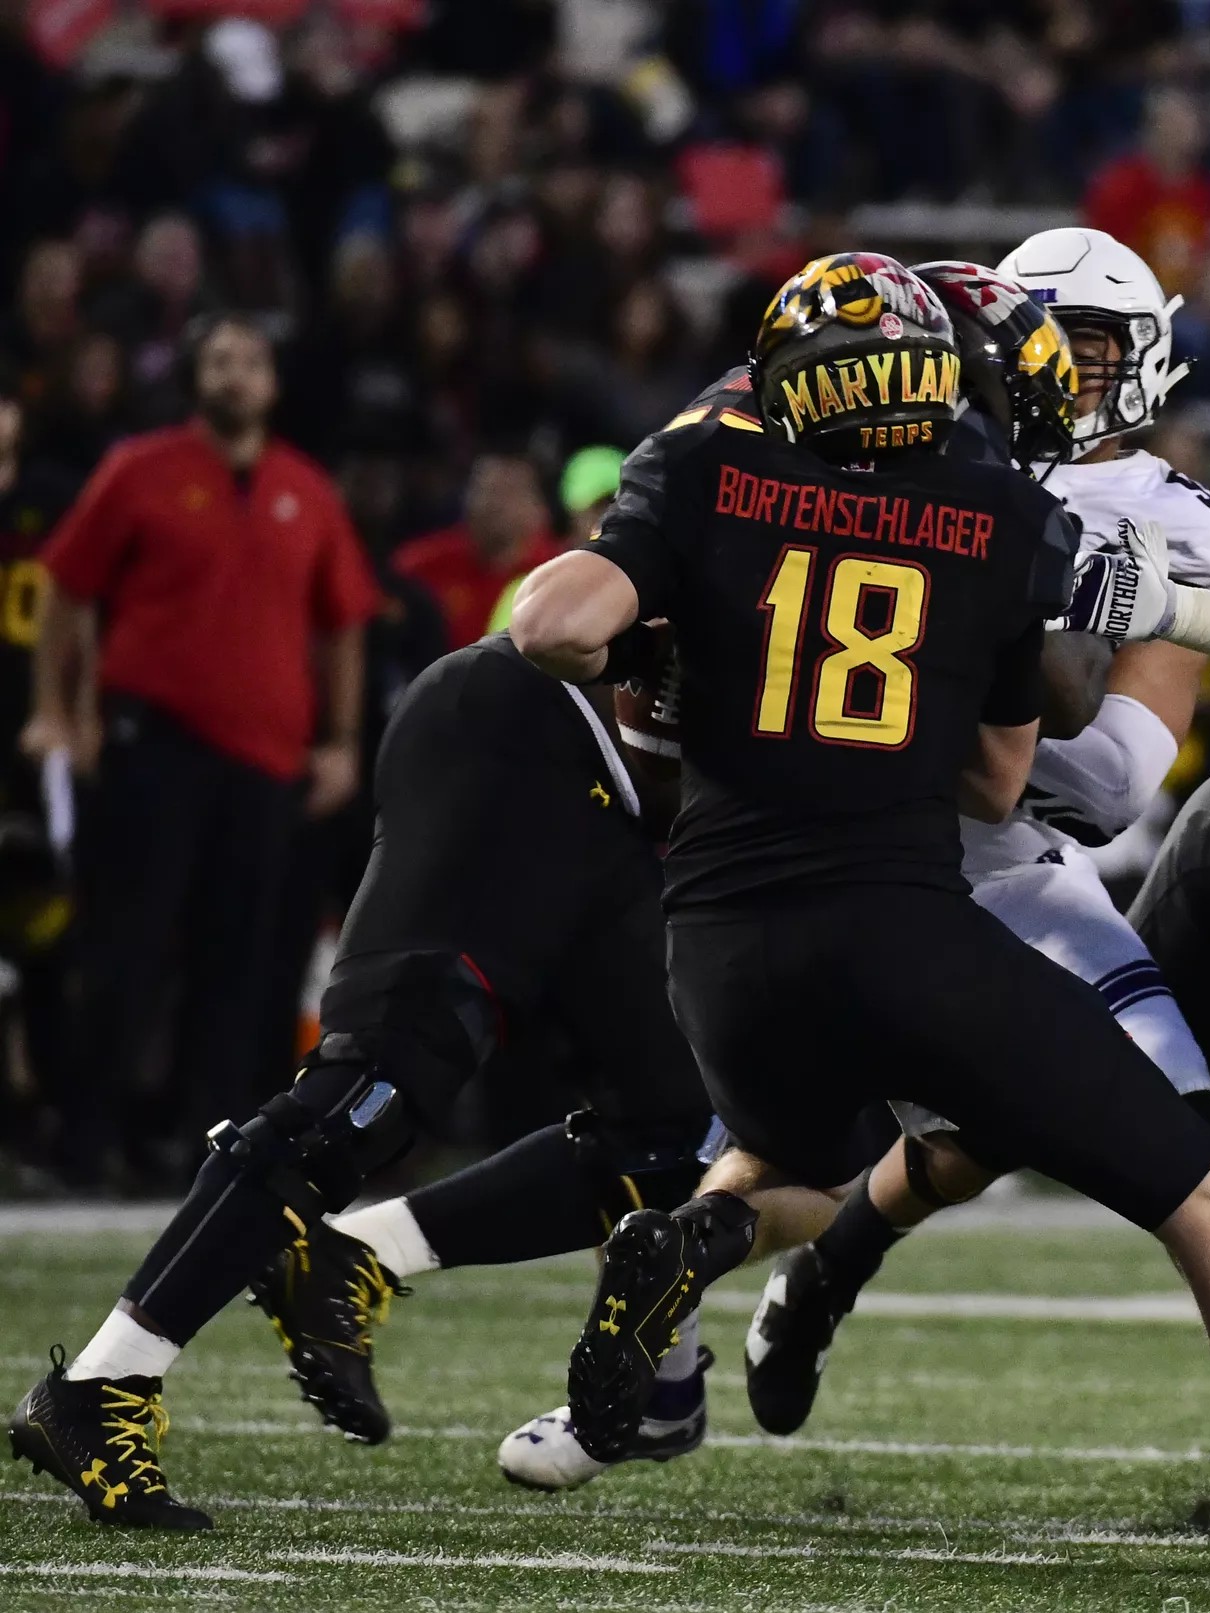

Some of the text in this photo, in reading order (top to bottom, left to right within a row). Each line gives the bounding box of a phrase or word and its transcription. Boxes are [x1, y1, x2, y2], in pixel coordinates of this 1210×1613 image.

[860, 421, 933, 449] TERPS
[715, 464, 994, 560] BORTENSCHLAGER
[751, 543, 932, 751] 18
